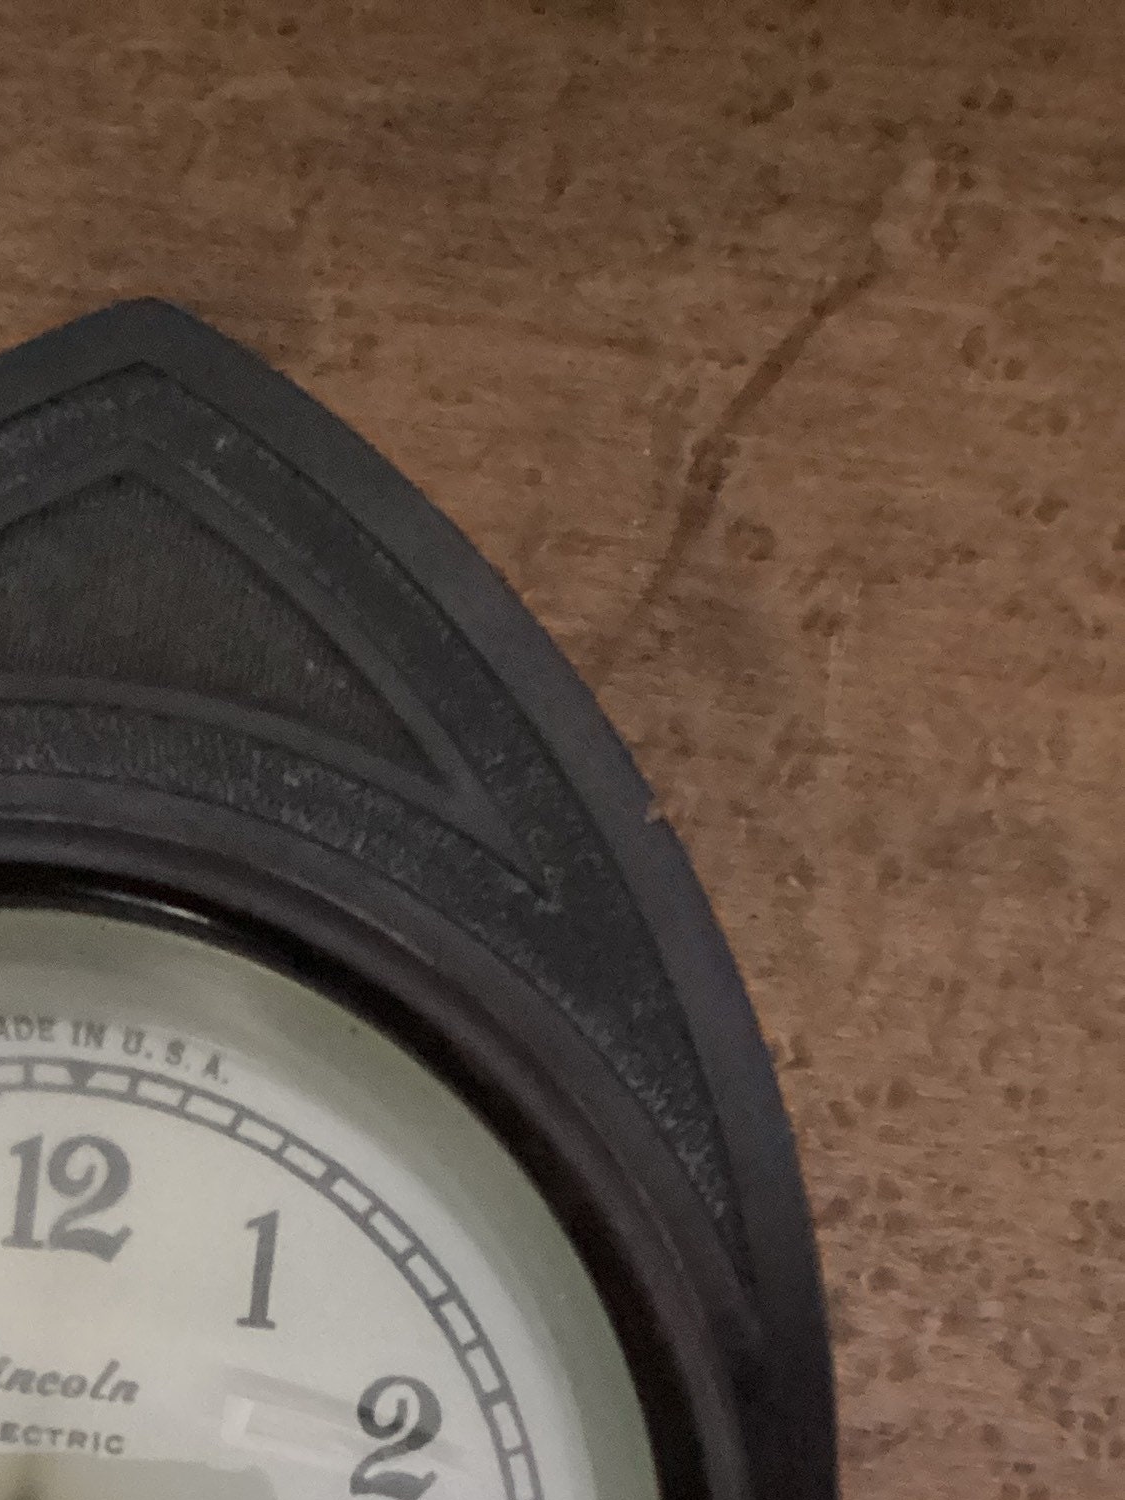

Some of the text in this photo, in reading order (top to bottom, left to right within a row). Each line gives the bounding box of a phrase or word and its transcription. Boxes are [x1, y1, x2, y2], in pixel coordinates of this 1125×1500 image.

[69, 1018, 107, 1049] IN
[1, 1132, 133, 1263] 12
[235, 1209, 281, 1331] 1
